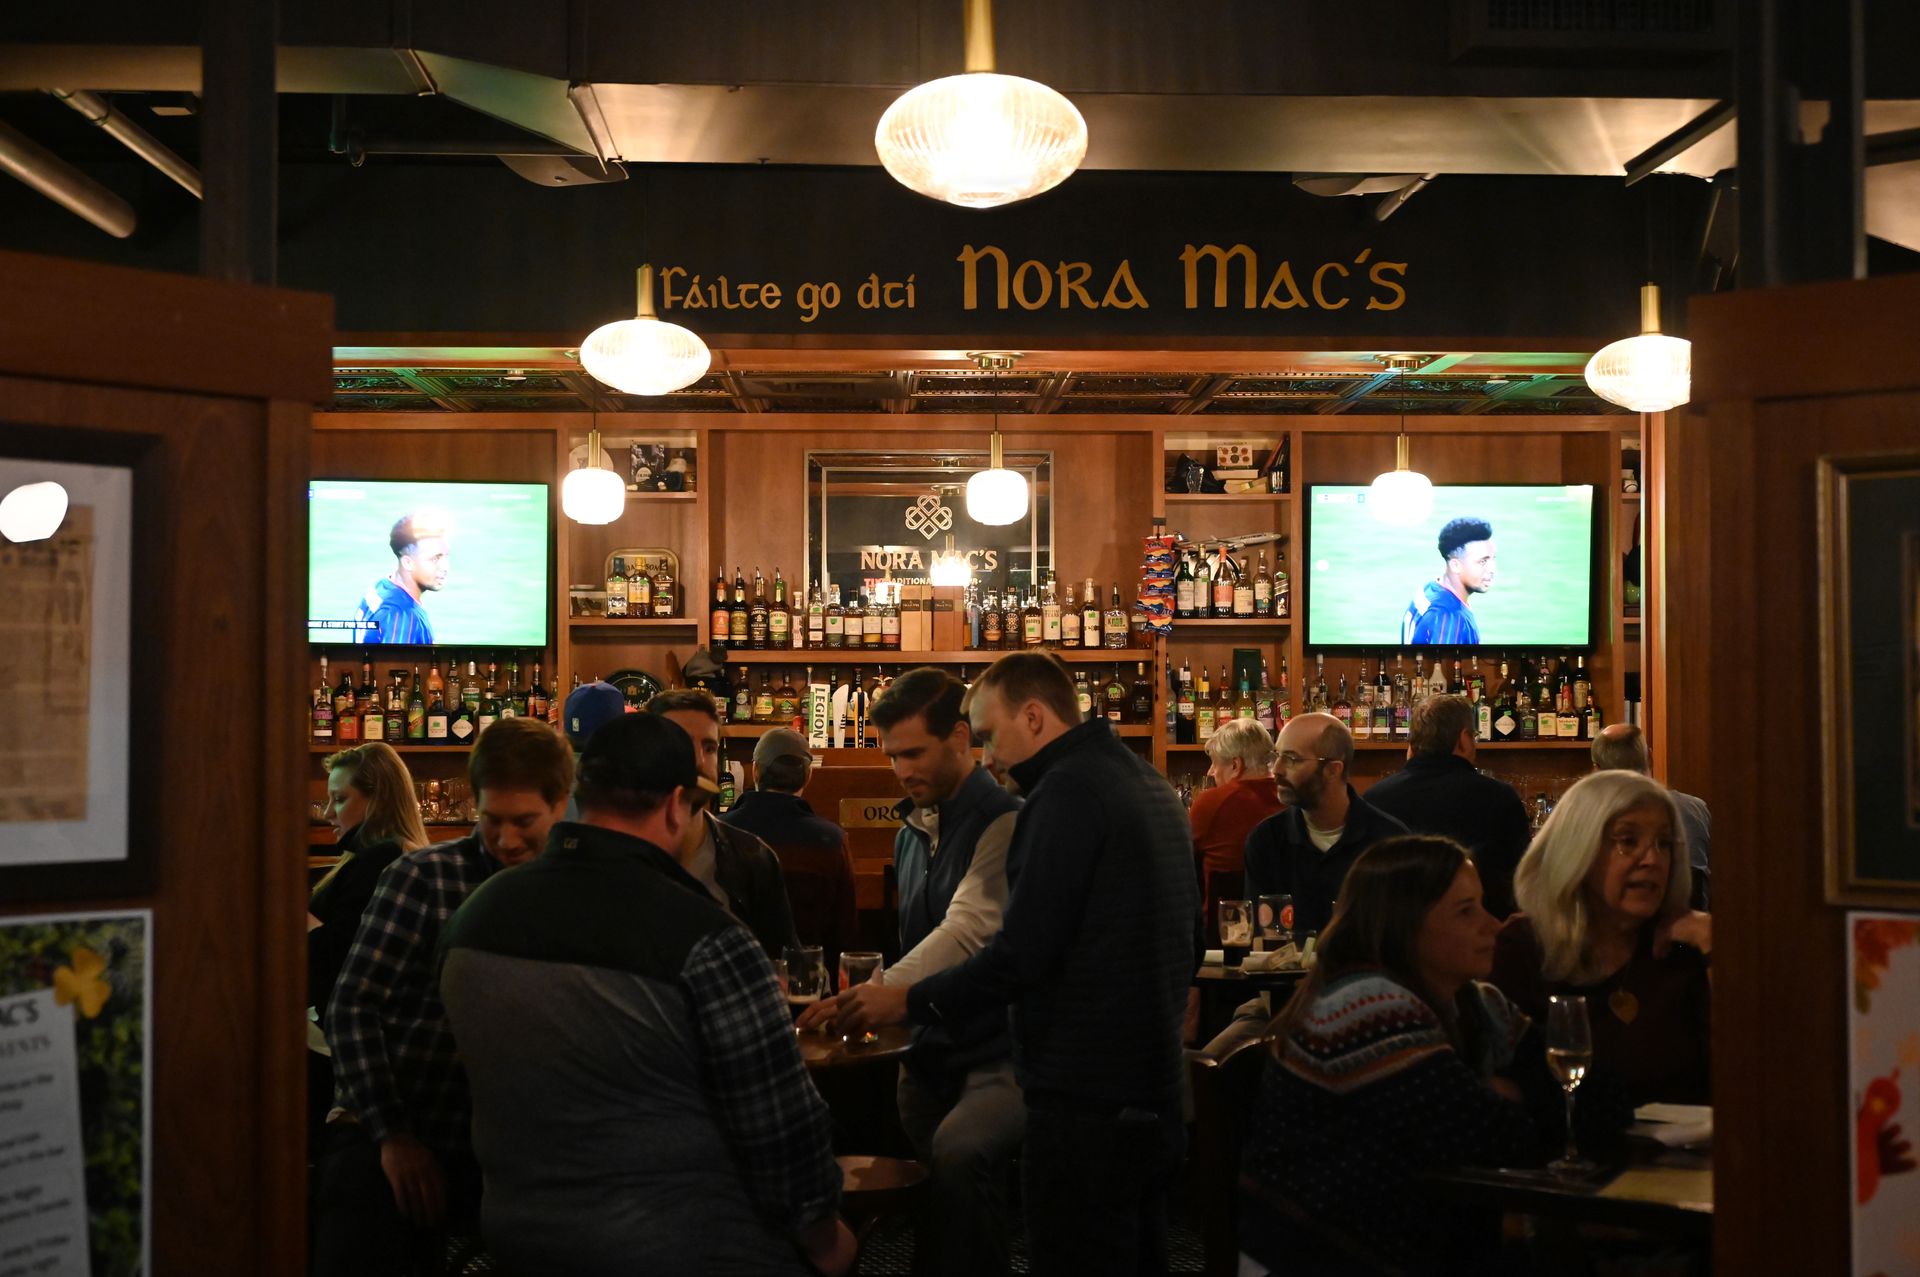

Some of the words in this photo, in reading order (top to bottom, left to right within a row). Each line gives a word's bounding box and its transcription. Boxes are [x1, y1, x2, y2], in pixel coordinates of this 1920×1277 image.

[659, 266, 782, 310] Fáilte
[796, 281, 841, 324] go
[856, 272, 917, 310] dtí
[859, 549, 924, 571] NORA
[930, 549, 999, 571] MC'S
[812, 687, 826, 739] LEGION
